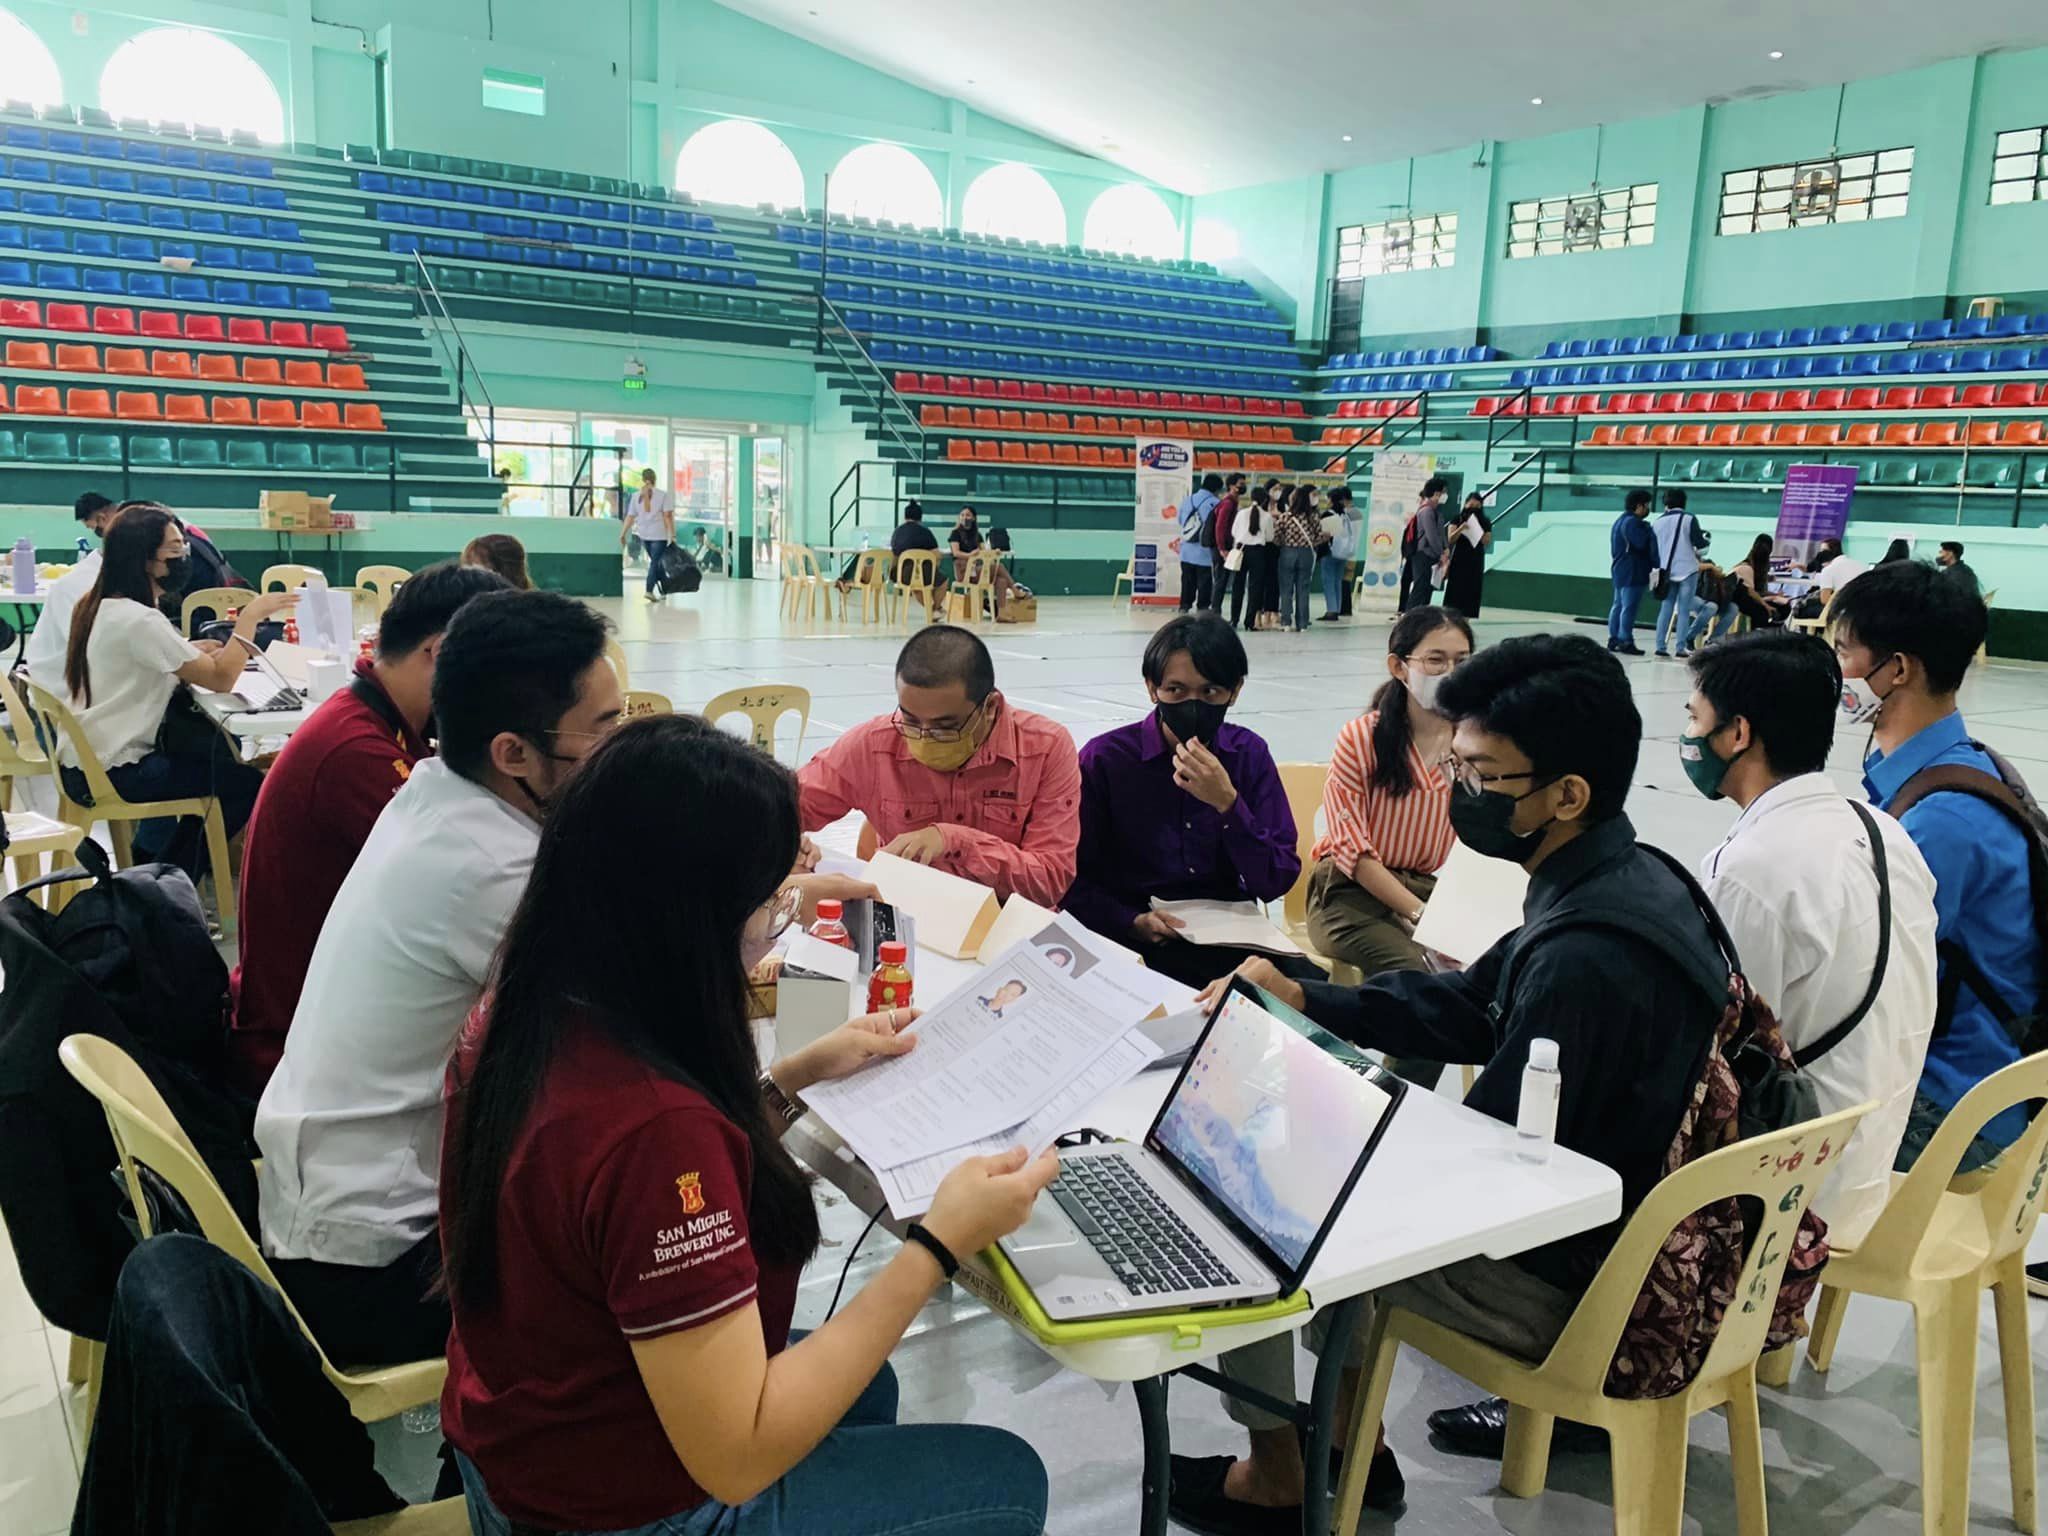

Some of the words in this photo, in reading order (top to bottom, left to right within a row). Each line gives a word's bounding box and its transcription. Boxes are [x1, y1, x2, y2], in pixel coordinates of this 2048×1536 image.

[657, 1225, 685, 1245] SAN
[687, 1209, 732, 1236] MIGUEL
[653, 1231, 714, 1263] BREWERY
